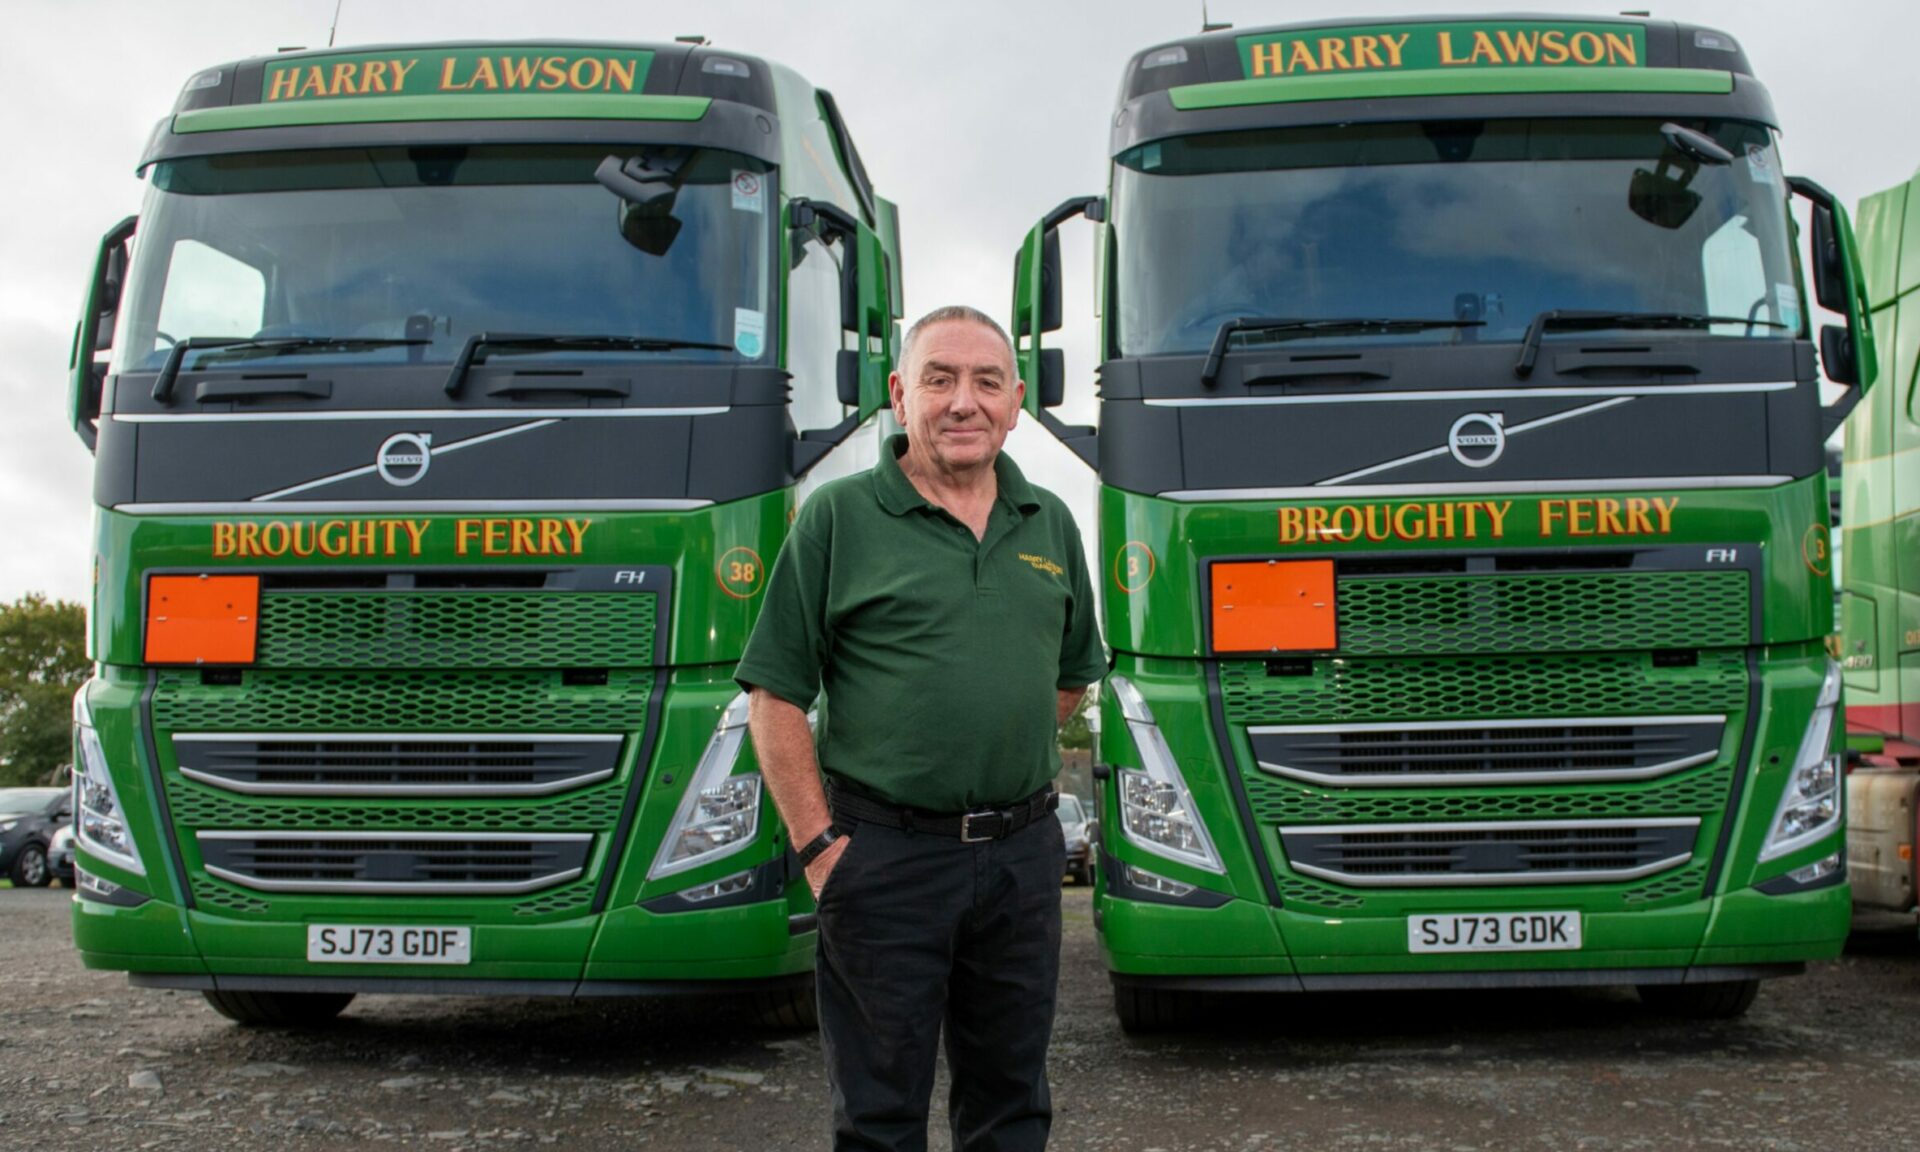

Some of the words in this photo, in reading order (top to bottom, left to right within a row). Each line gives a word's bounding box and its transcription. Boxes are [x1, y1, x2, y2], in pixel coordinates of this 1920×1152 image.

[1252, 33, 1410, 78] HARRY
[1438, 30, 1638, 66] LAWSON
[268, 58, 419, 102] HARRY
[439, 56, 637, 92] LAWSON
[1457, 436, 1497, 444] VOLVO
[383, 455, 423, 464] VOLVO
[1278, 500, 1512, 544] BROUGHTY
[1539, 496, 1680, 537] FERRY
[213, 519, 431, 559] BROUGHTY
[455, 518, 592, 557] FERRY
[1705, 548, 1737, 563] FH
[614, 570, 646, 585] FH
[730, 561, 755, 582] 38
[320, 928, 394, 955] SJ73
[402, 930, 458, 956] GDF
[1421, 917, 1501, 946] SJ73
[1509, 915, 1568, 944] GDK
